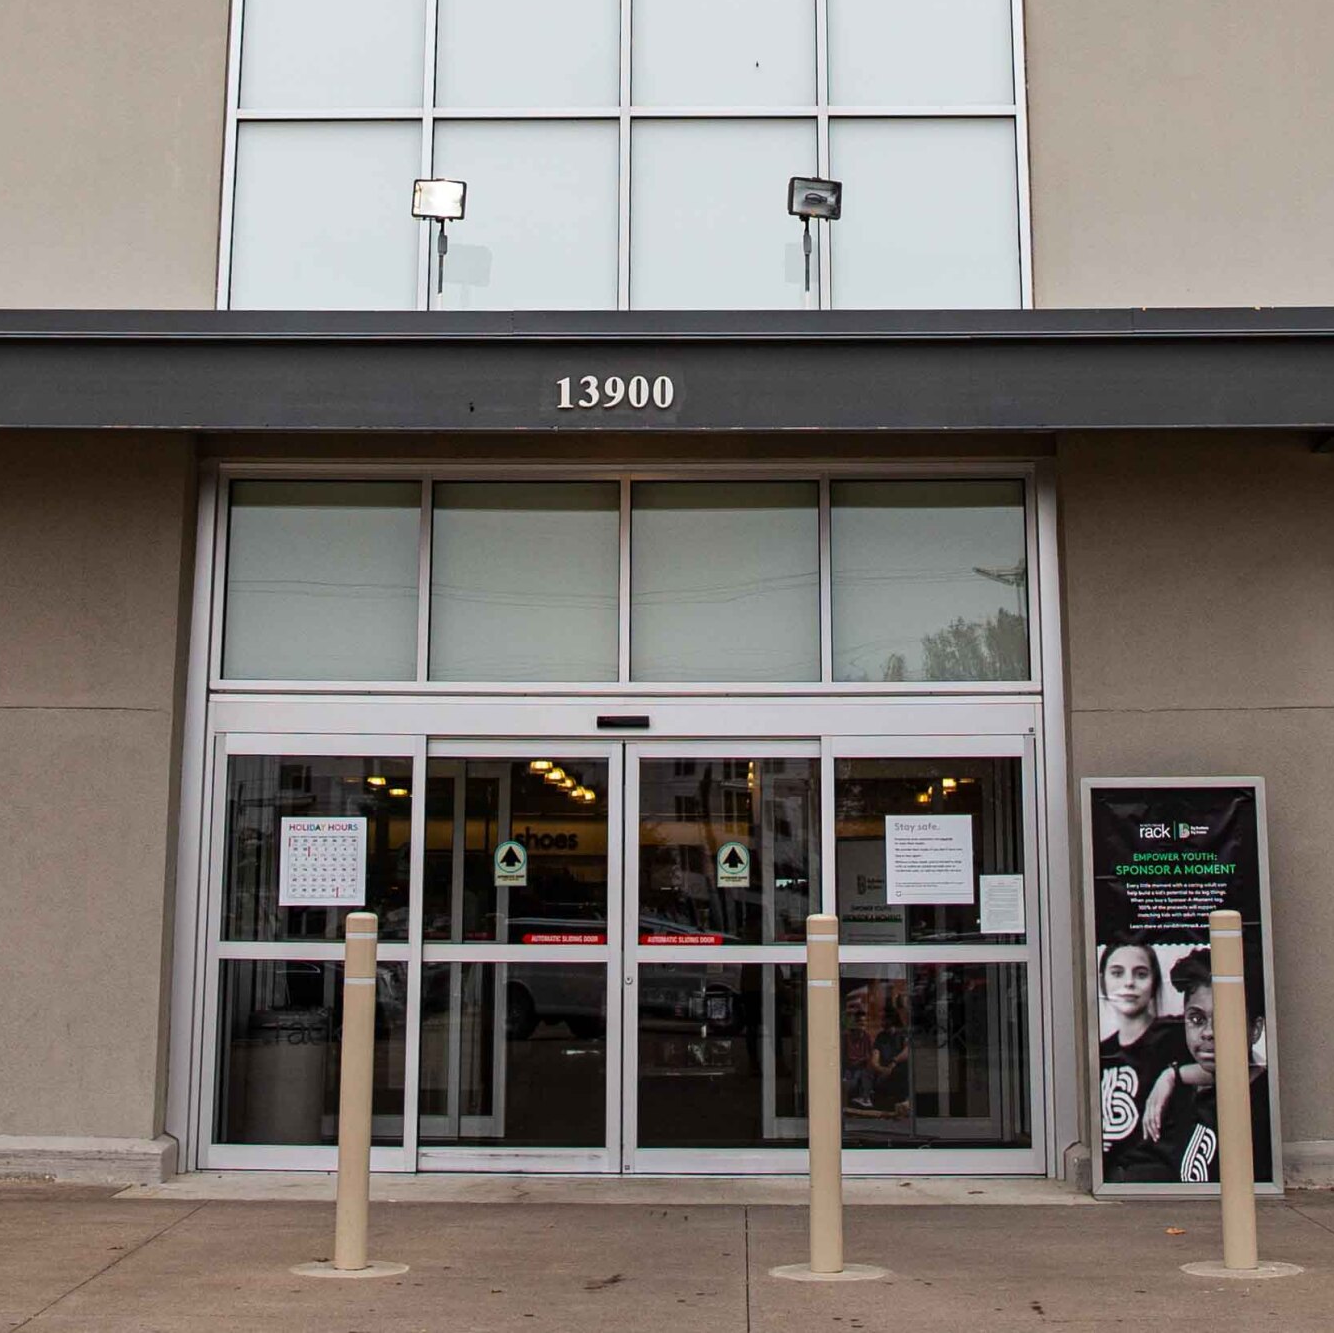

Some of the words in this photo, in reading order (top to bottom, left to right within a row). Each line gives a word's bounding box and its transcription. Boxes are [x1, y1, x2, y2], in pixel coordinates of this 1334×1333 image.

[556, 374, 675, 409] 13900
[288, 823, 327, 832] HOLIDAY
[327, 823, 359, 832] HOURS
[894, 822, 916, 834] Stay
[1139, 823, 1171, 839] rack
[514, 826, 579, 851] shoes
[1133, 853, 1179, 862] EMPOWER
[1181, 852, 1218, 861] YOUTH:
[1115, 865, 1171, 875] SPONSOR
[1173, 865, 1182, 875] A
[1184, 864, 1236, 875] MOMENT
[531, 935, 561, 943] AUTOMATIC
[561, 935, 583, 943] SLIDING
[583, 935, 599, 943] DOOR
[647, 936, 677, 944] AUTOMATIC
[678, 936, 699, 944] SLIDING
[699, 936, 715, 944] DOOR
